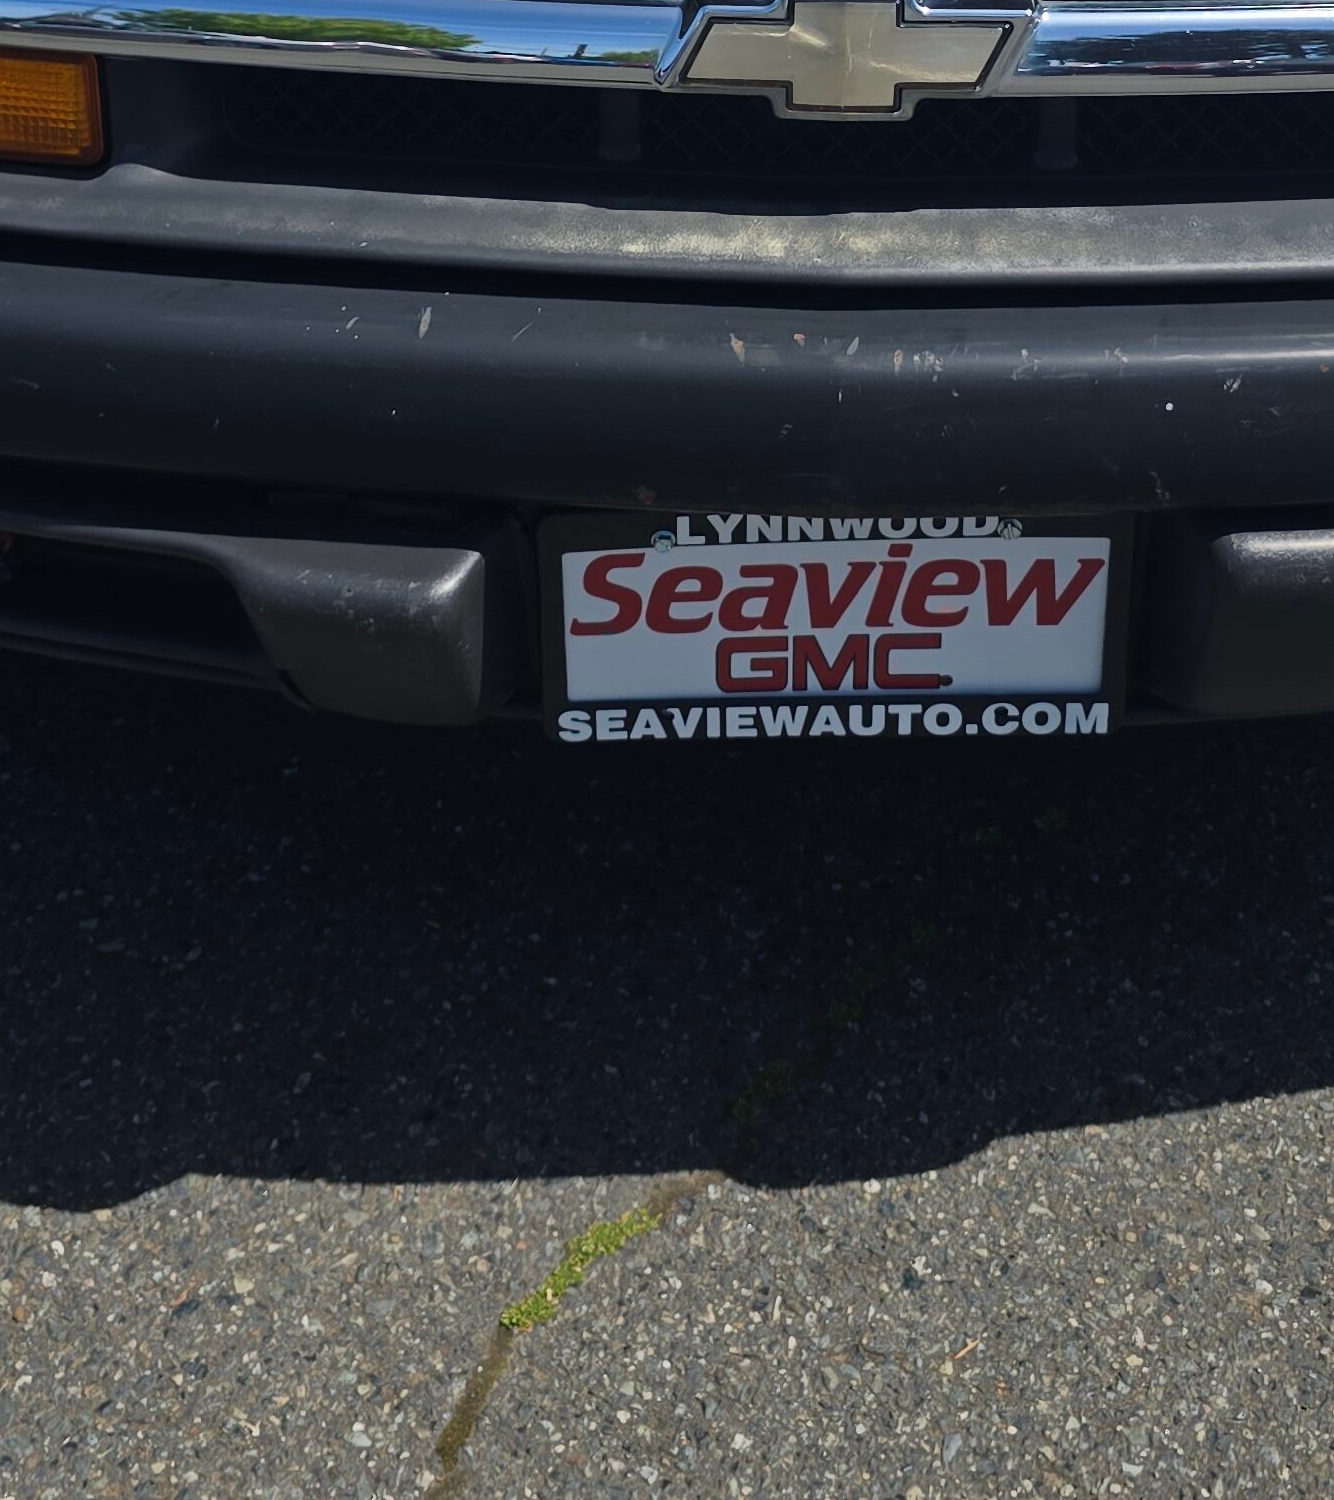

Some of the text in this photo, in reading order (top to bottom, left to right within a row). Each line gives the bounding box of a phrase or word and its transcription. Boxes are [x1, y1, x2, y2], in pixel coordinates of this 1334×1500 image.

[676, 513, 999, 545] LYNNWOOD
[570, 543, 1106, 636] Seaview
[715, 632, 942, 693] GMC
[557, 702, 1110, 742] SEAVIEWAUTO.COM
